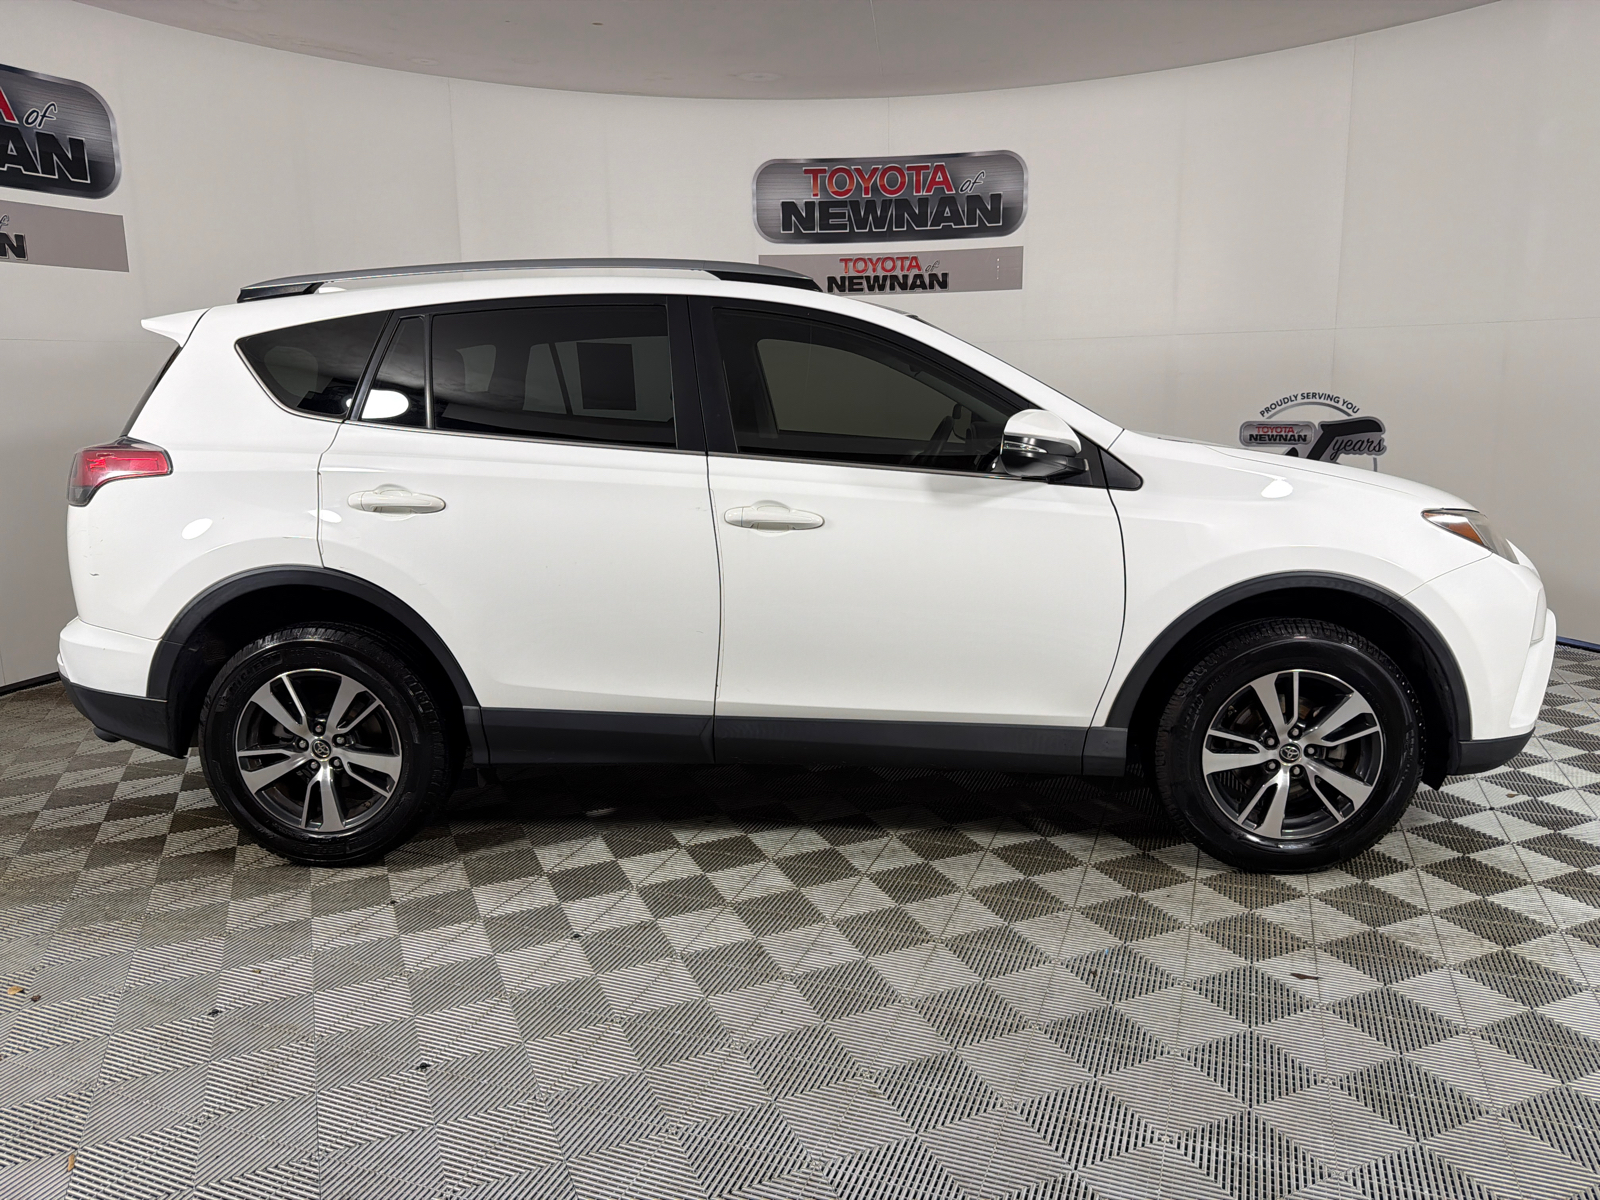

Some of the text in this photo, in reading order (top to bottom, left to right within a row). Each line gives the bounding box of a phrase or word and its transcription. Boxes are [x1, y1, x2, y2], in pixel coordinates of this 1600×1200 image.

[24, 101, 58, 129] of
[803, 162, 985, 198] TOYOTA of
[780, 193, 1003, 234] NEWNAN
[839, 255, 940, 274] TOYOTA of
[826, 272, 949, 293] NEWNAN
[1259, 392, 1360, 418] PROUDLY SERVING YOU
[1248, 433, 1308, 442] NEWNAN
[1255, 425, 1295, 434] TOYOTA
[1330, 438, 1384, 461] years
